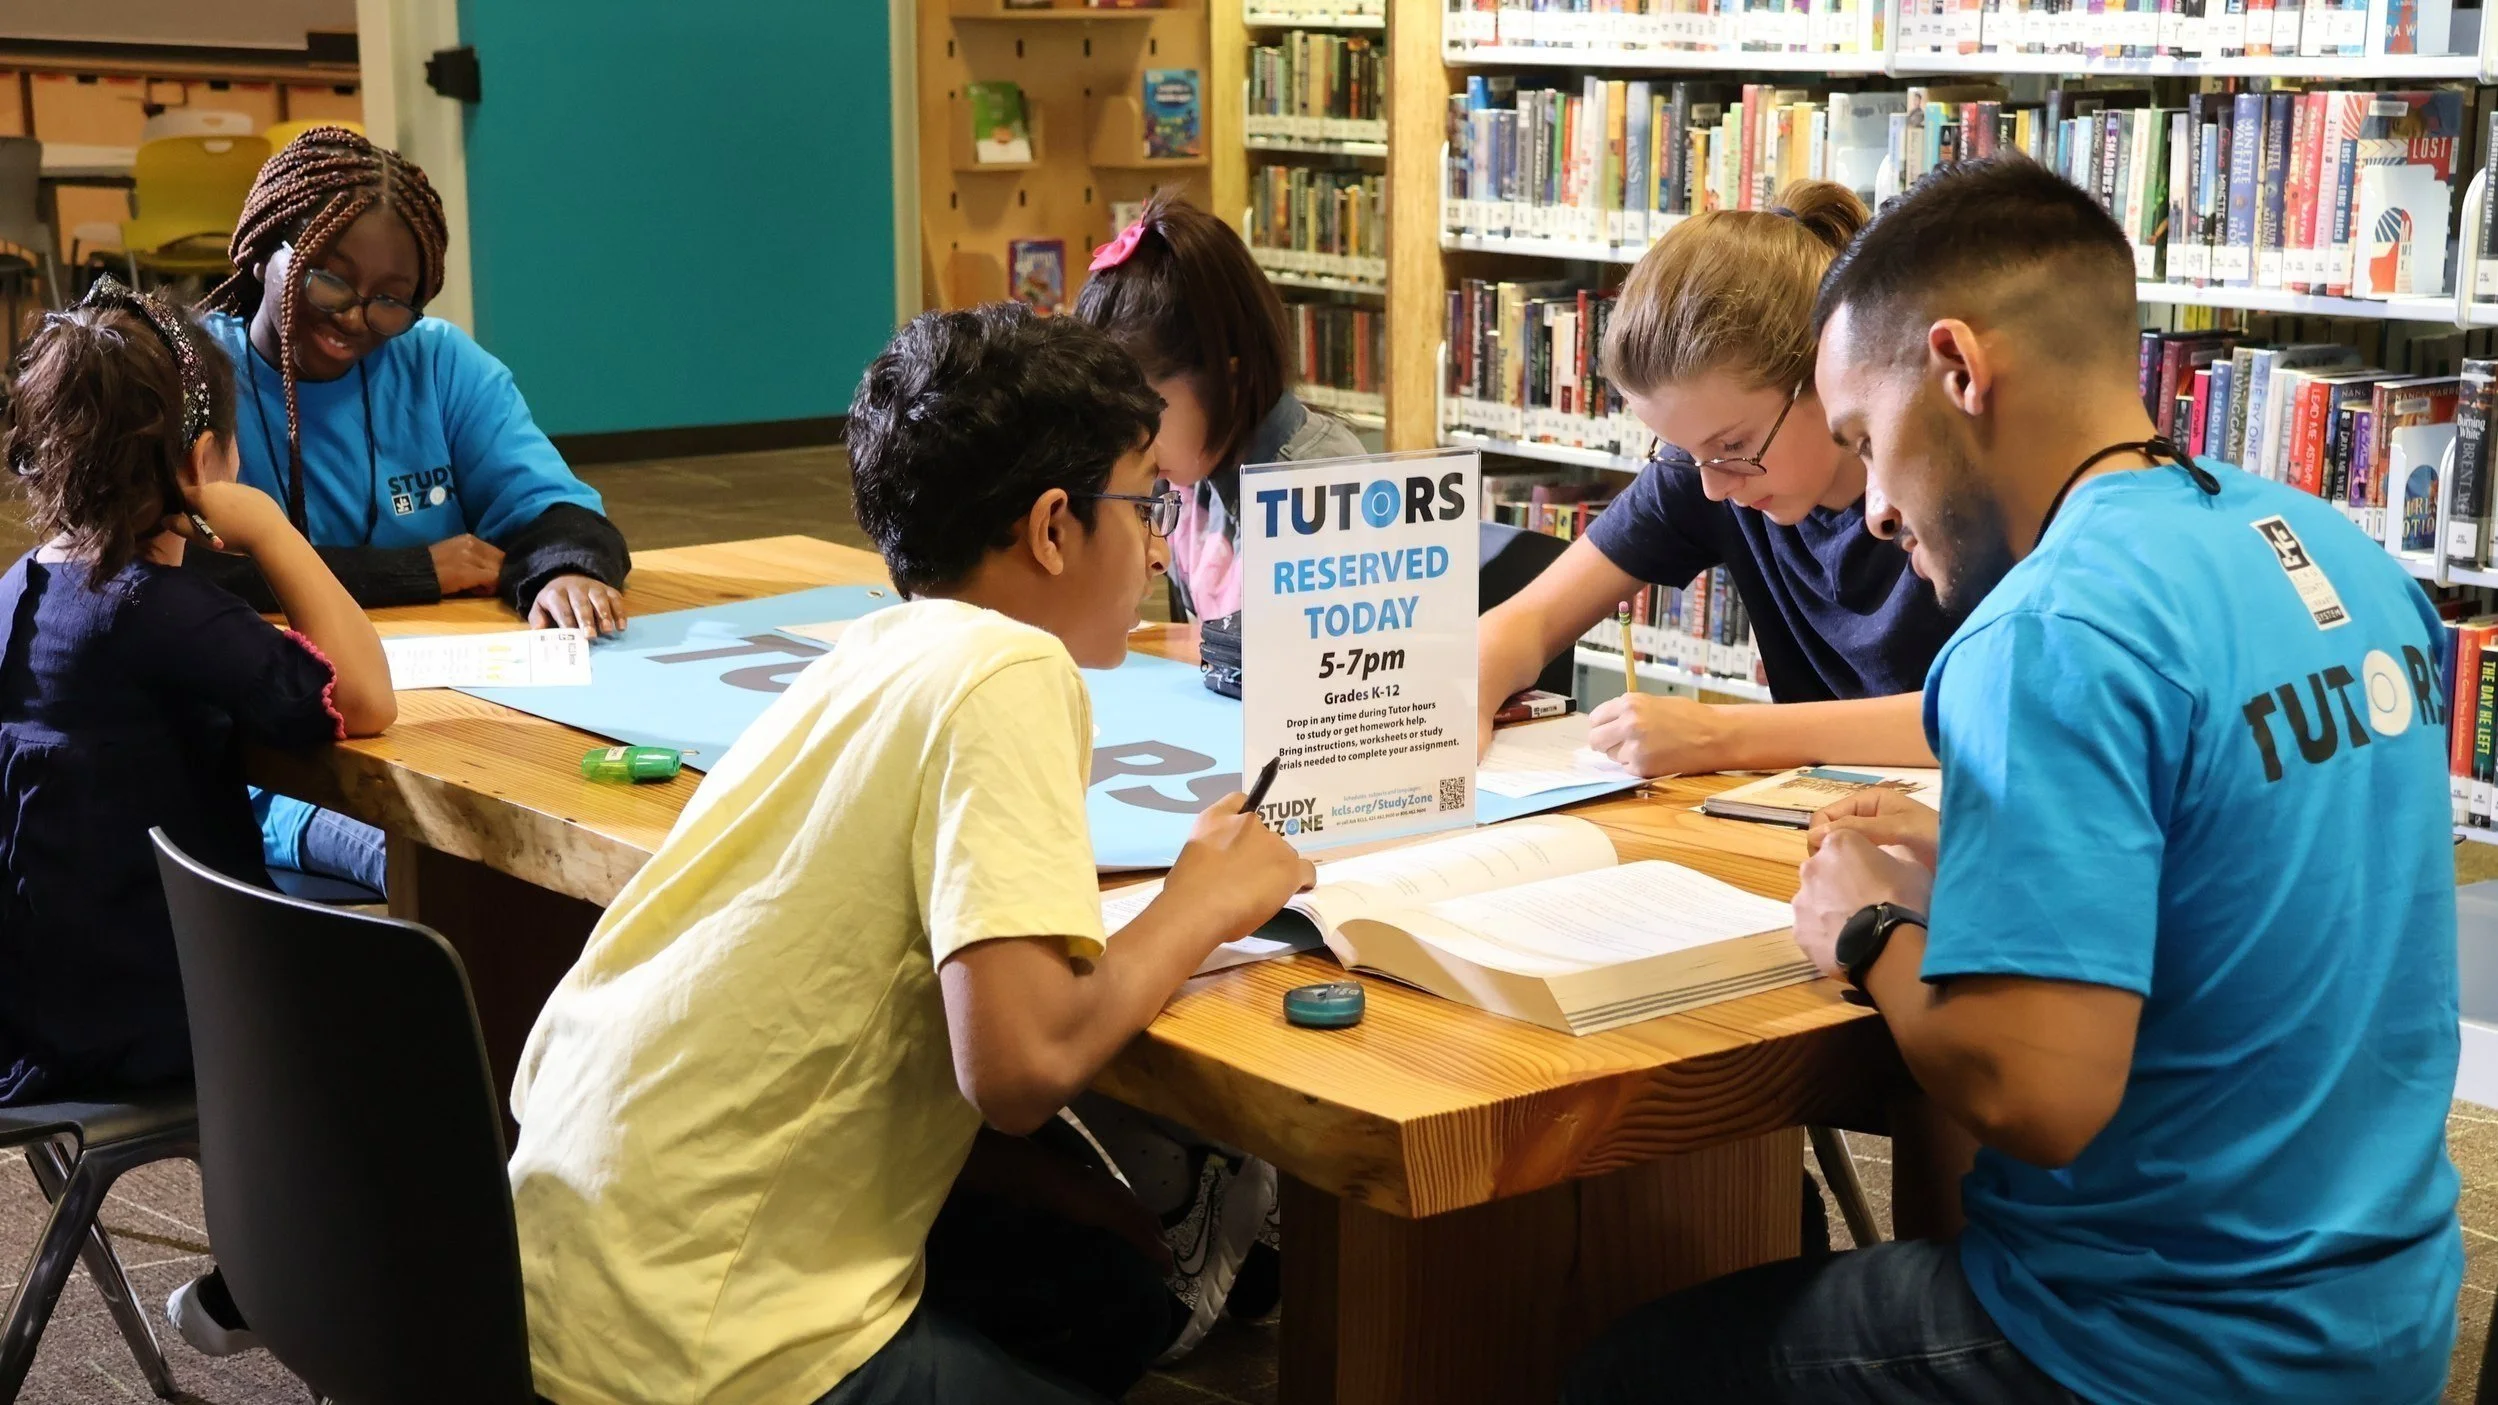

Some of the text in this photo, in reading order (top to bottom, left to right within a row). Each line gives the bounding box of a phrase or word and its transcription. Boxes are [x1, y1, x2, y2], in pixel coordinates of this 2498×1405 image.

[2193, 118, 2201, 146] ANGEL
[2292, 104, 2304, 142] OPAL
[2306, 106, 2318, 147] FAMILY
[2192, 148, 2199, 160] OF
[2232, 119, 2244, 184] WALTERS
[2241, 118, 2255, 184] MINETTE
[2266, 120, 2275, 170] WALTERS
[2274, 120, 2284, 170] MINETTE
[2341, 142, 2352, 164] LOST
[2412, 136, 2447, 160] LOST
[2101, 135, 2117, 193] SHADOWS
[2304, 152, 2314, 190] TRUST
[2488, 175, 2495, 184] OF
[2216, 174, 2227, 219] MINETTE
[2337, 184, 2347, 207] LONG
[2486, 187, 2494, 202] THE
[2334, 209, 2346, 240] MARCH
[2484, 204, 2493, 224] LAKE
[2216, 379, 2223, 387] A
[2192, 409, 2200, 439] crush
[2211, 391, 2222, 434] DEADLY
[2227, 373, 2243, 460] LYING GAME
[2246, 364, 2265, 459] ONE BY ONE
[2457, 414, 2486, 432] Burning
[2304, 389, 2321, 485] LEAD ME ASTRAY
[2459, 426, 2481, 441] White
[2335, 431, 2350, 500] DRIVE ME WILD
[2456, 442, 2472, 488] BRENT
[1256, 472, 1465, 538] TUTORS
[1274, 545, 1449, 594] RESERVED
[1304, 595, 1419, 639] TODAY
[2316, 607, 2342, 622] SYSTEM
[1318, 648, 1405, 680] 5-7pm
[2462, 662, 2471, 677] Life
[1324, 684, 1400, 705] Grades K-12
[2476, 660, 2497, 755] THE DAY HE LEFT
[1286, 701, 1436, 729] Drop in any time during Tutor hours
[1296, 716, 1427, 741] to study or get homework help.
[1278, 738, 1460, 771] erials needed to complete your assignment.
[1279, 726, 1443, 758] Bring instructions, worksheets or study
[1257, 797, 1317, 821] STUDY
[1331, 793, 1433, 818] kcls.org/StudyZone
[1276, 814, 1323, 837] ZONE
